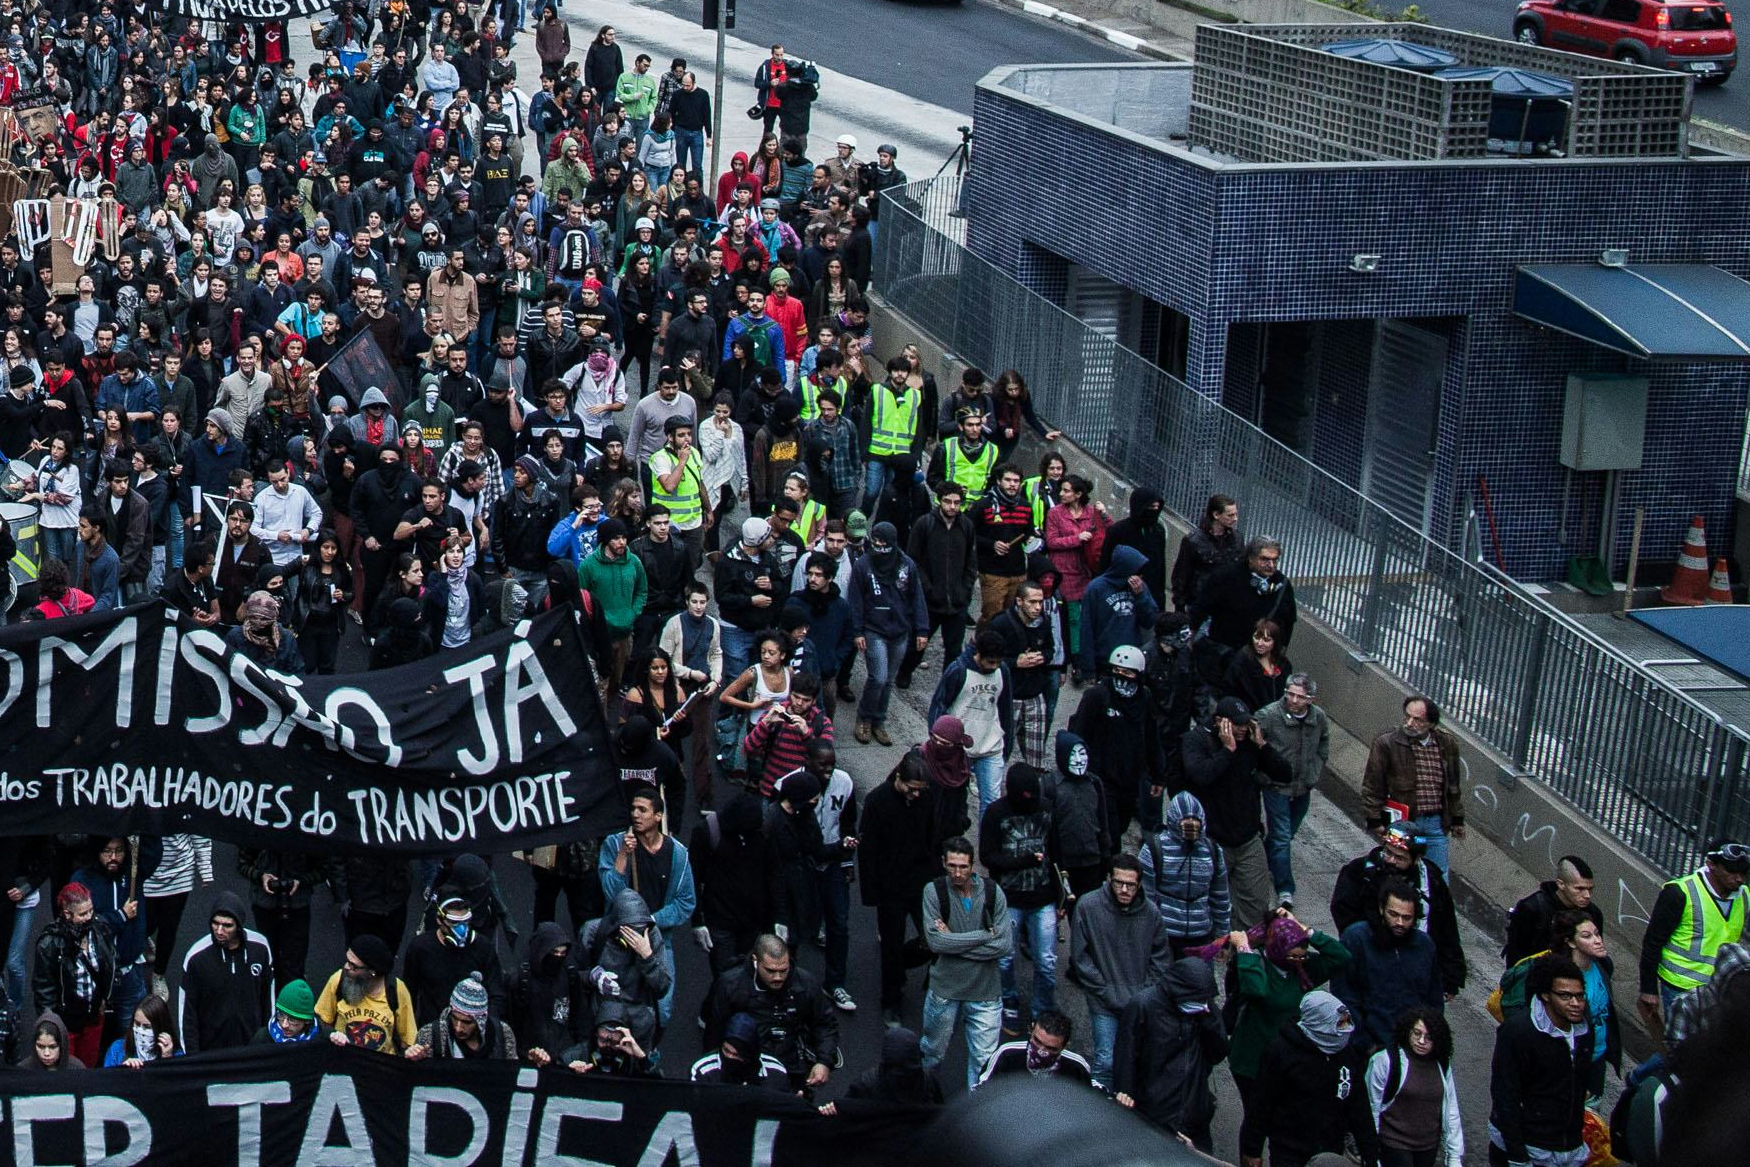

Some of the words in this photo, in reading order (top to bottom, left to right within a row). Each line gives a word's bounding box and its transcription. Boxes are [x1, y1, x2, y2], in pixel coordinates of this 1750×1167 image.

[443, 619, 578, 777] JÁ
[42, 763, 293, 830] TRABALHADORES
[299, 791, 337, 839] do
[347, 770, 582, 845] TRANSPORTE
[830, 794, 845, 811] N
[364, 1008, 380, 1019] PAZ
